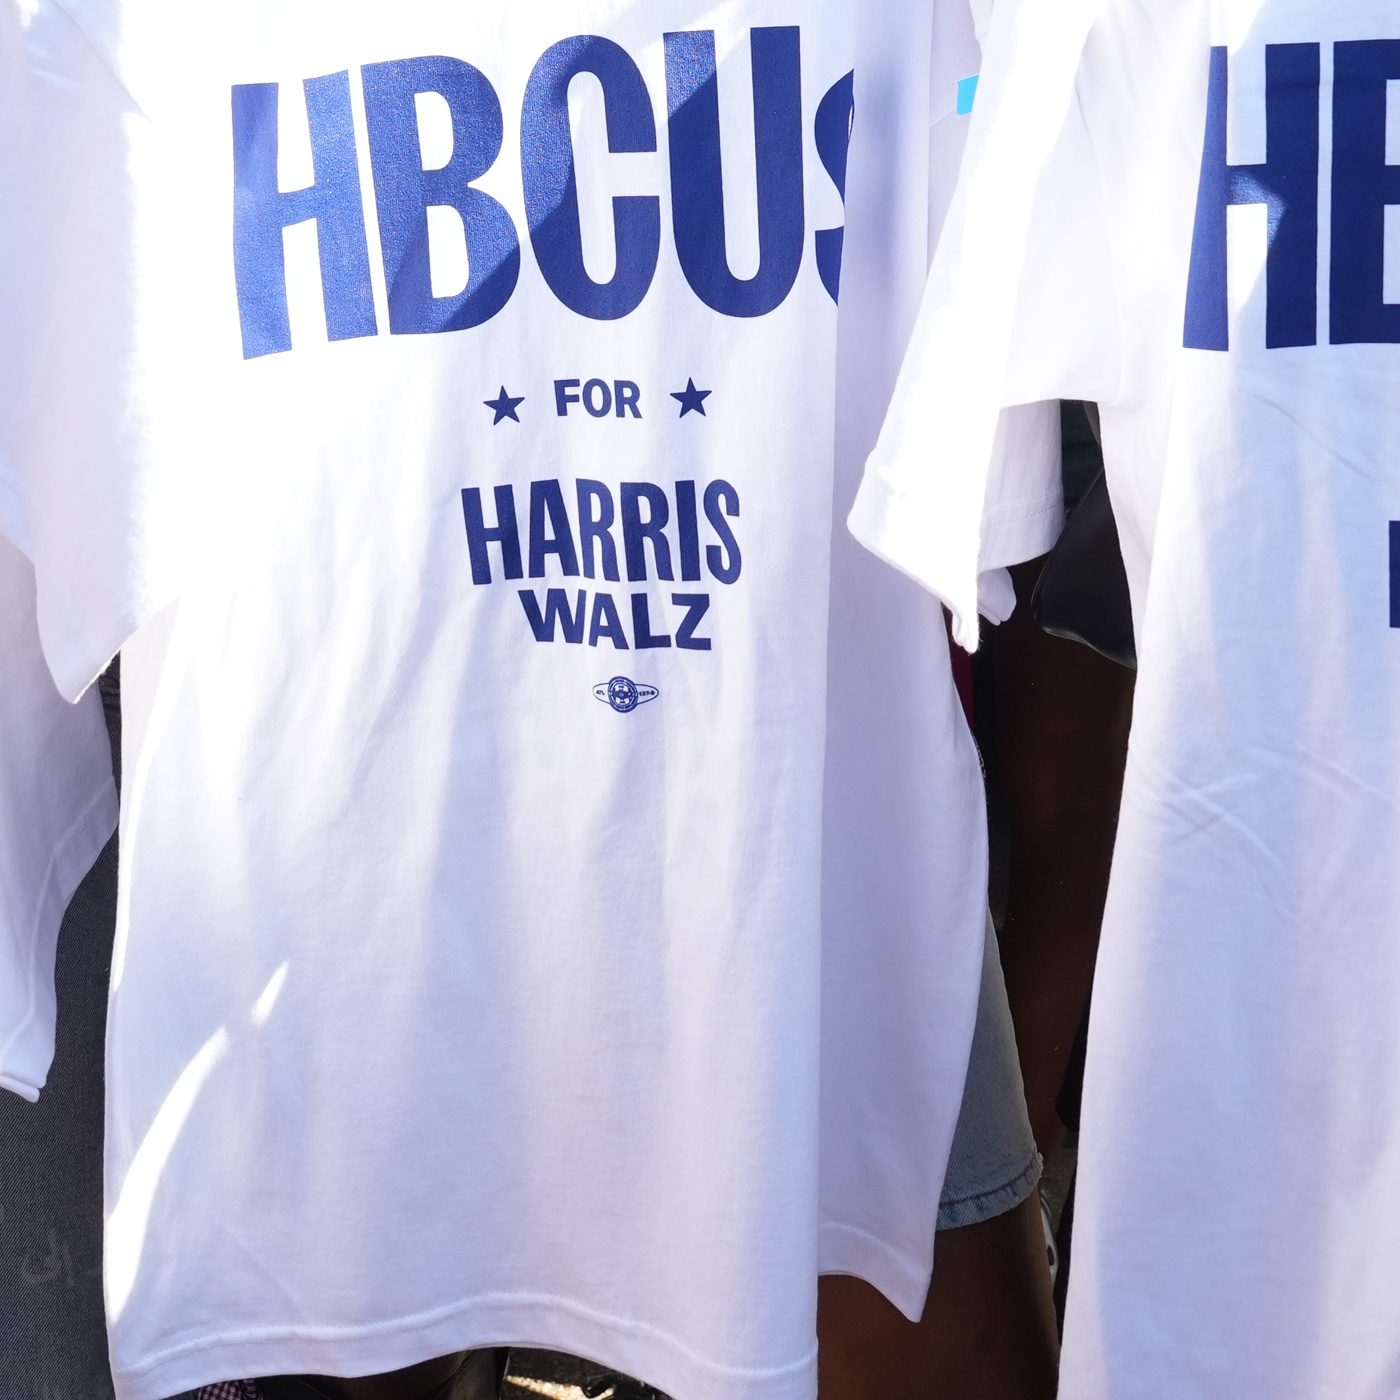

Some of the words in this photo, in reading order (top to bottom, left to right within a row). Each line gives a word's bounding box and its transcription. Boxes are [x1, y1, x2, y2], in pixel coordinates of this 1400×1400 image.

[554, 378, 642, 418] FOR
[461, 478, 742, 585] HARRIS
[518, 588, 712, 651] WALZ
